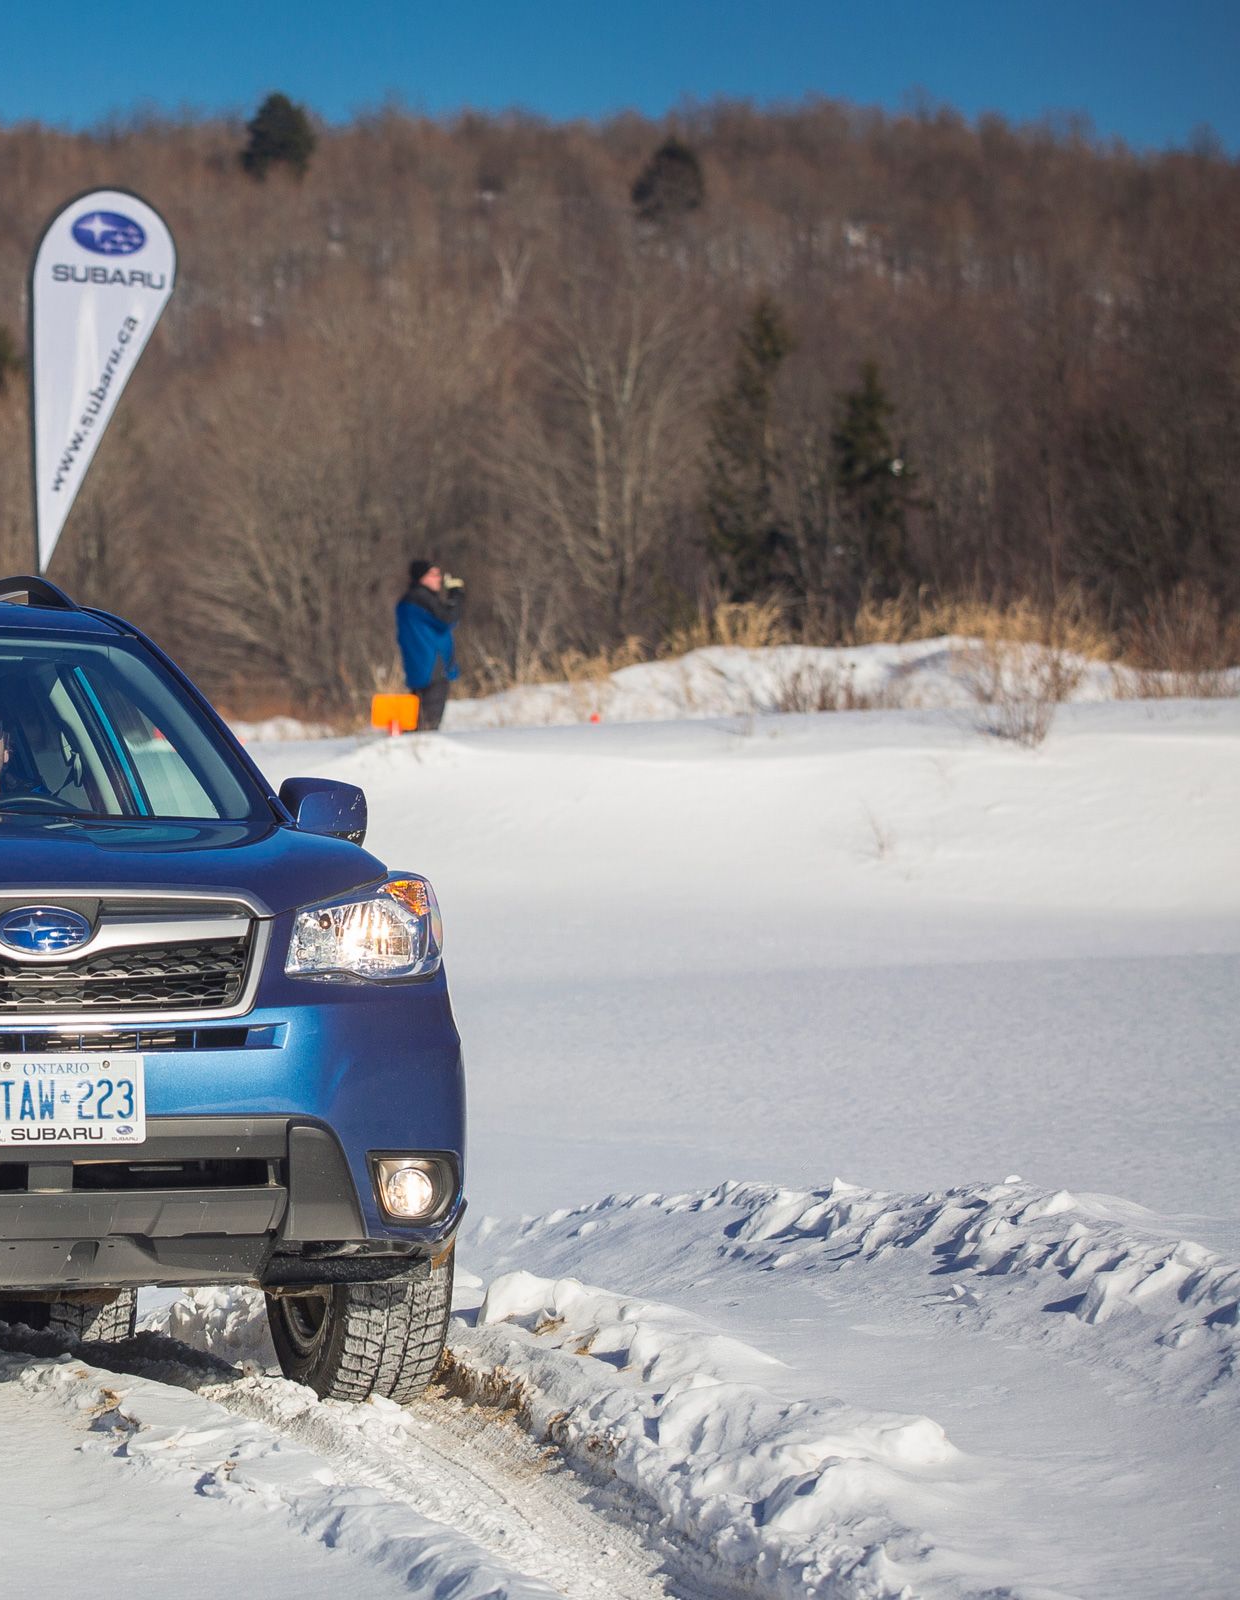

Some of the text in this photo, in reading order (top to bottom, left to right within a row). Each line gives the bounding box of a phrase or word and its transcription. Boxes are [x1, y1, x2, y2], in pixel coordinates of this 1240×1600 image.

[52, 264, 166, 289] SUBARU
[52, 315, 139, 492] www.subaru.ca
[23, 1062, 90, 1076] ONTARIO
[76, 1079, 134, 1120] 223
[11, 1127, 103, 1141] SUBARU
